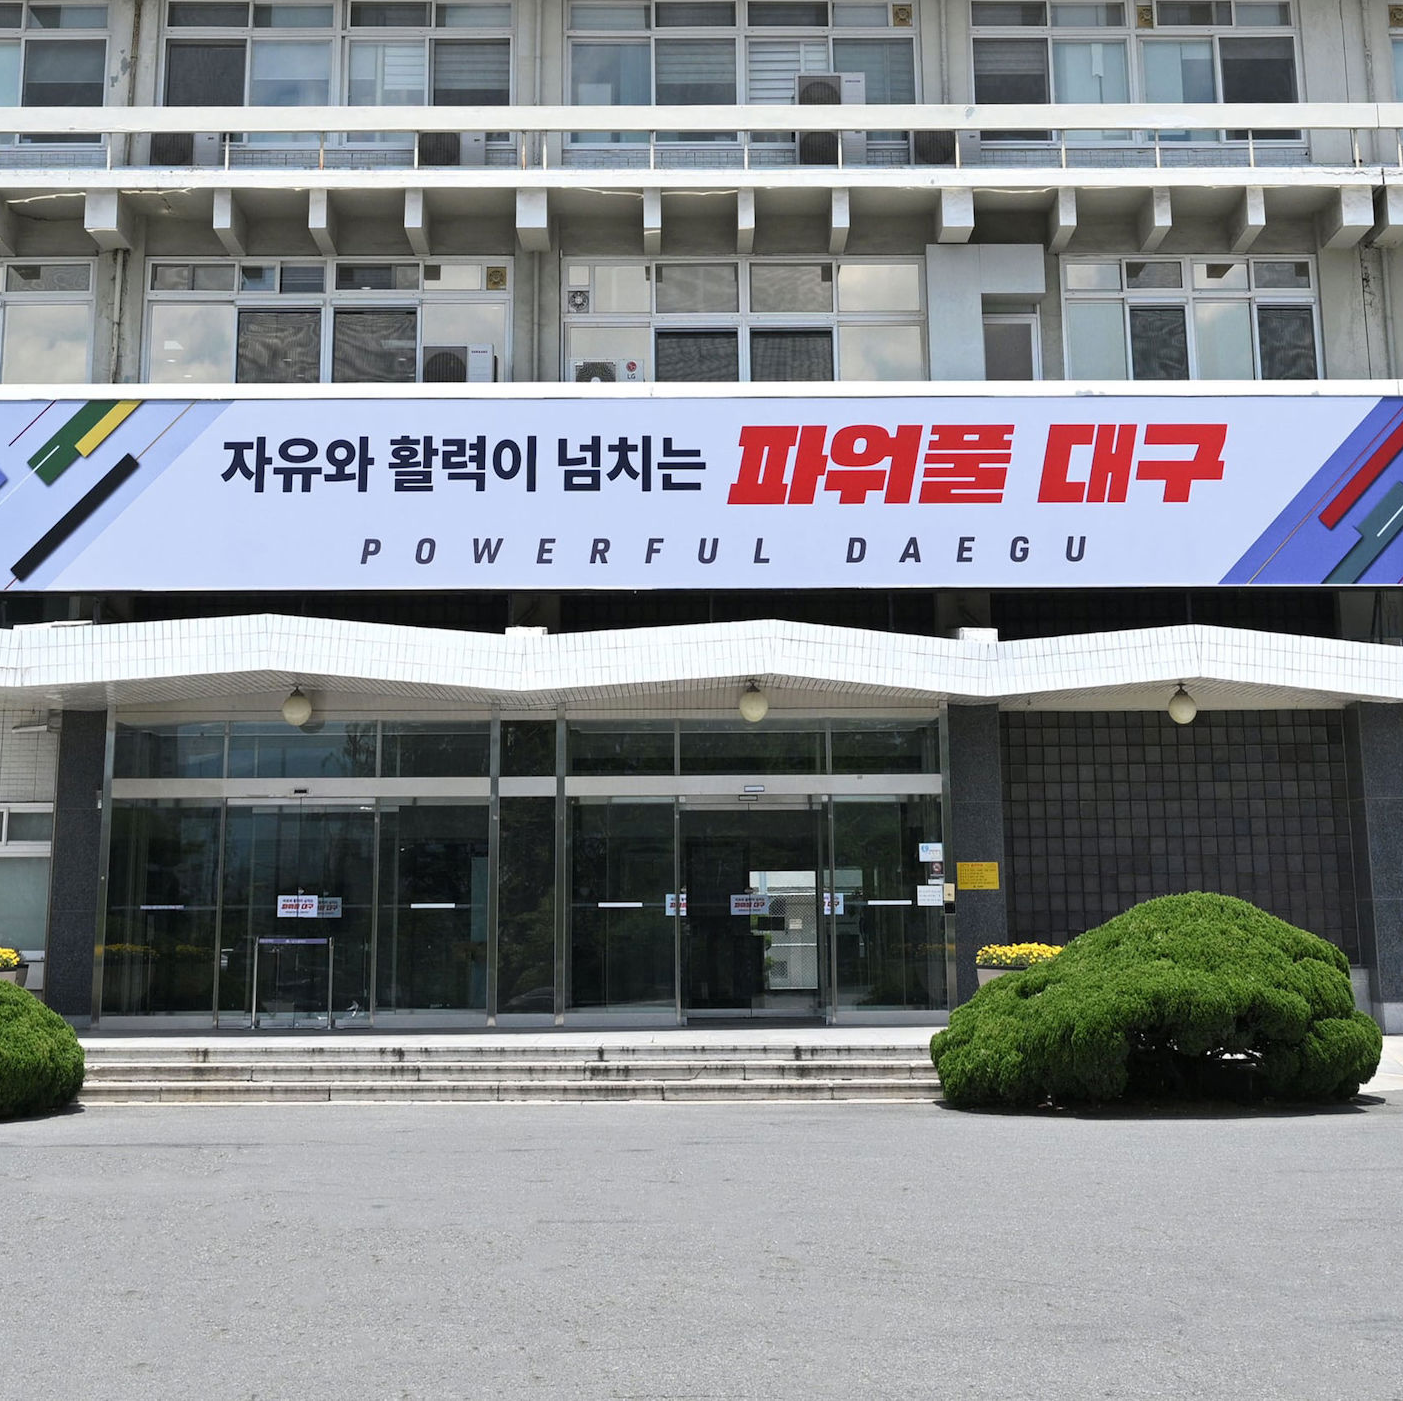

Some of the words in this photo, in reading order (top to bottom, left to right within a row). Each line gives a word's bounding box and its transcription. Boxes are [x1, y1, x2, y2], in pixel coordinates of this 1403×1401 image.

[221, 436, 375, 493] 자유와
[388, 435, 537, 492] 활력이
[557, 435, 707, 492] 넘치는
[727, 424, 1015, 505] 파워풀
[1037, 423, 1228, 503] 대구
[360, 537, 770, 565] POWERFUL
[845, 536, 1087, 563] DAEGU
